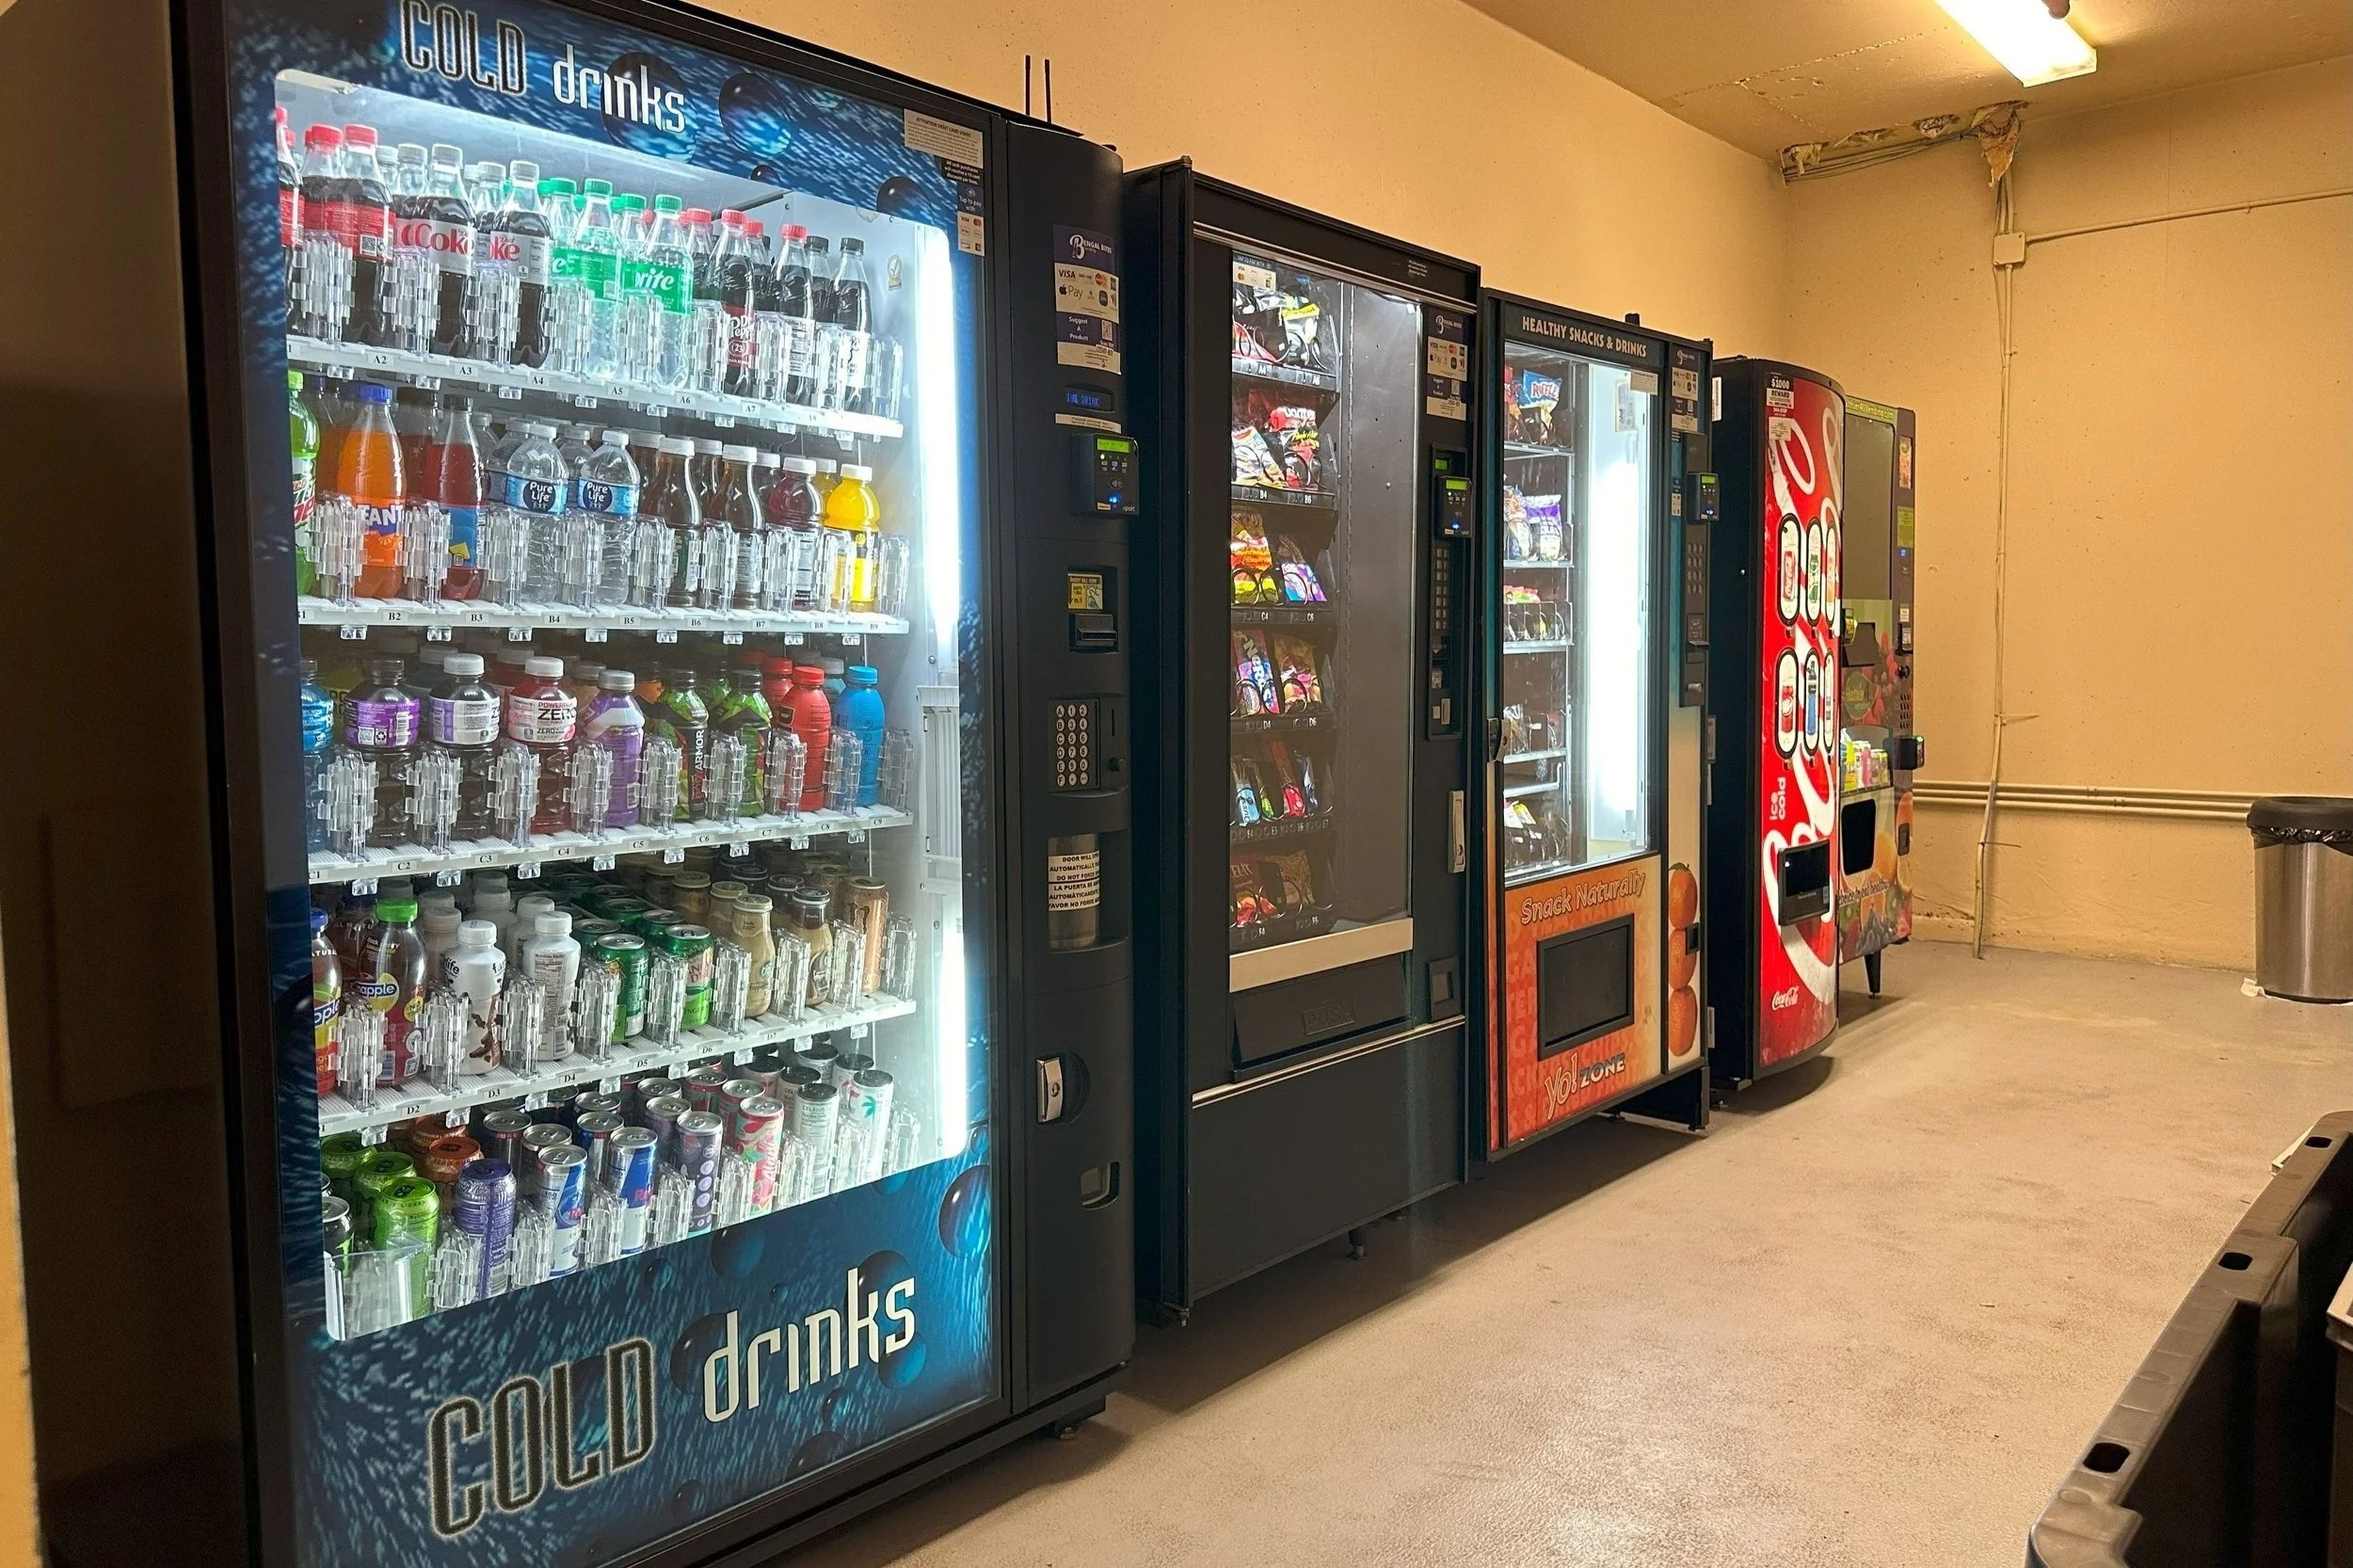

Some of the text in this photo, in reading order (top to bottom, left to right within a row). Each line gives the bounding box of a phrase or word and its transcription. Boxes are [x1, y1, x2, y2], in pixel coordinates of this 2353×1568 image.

[401, 0, 686, 134] COLD drinks
[916, 117, 937, 127] ATTENTION
[415, 224, 474, 257] Coke
[1058, 269, 1076, 279] VISA
[1068, 285, 1083, 300] Pay
[1068, 316, 1088, 325] Suggest
[1522, 316, 1647, 358] HEALTHY SNACKS & DRINKS
[373, 354, 387, 364] A2
[458, 366, 472, 376] A3
[531, 376, 544, 385] A4
[611, 386, 623, 395] A5
[679, 395, 691, 404] A6
[745, 404, 757, 413] A7
[1771, 378, 1790, 390] $1000
[1771, 390, 1790, 398] REWARD
[530, 481, 553, 494] Pure
[586, 481, 608, 494] Pure
[532, 491, 550, 503] Life
[588, 490, 605, 503] Life
[1259, 490, 1312, 504] B4 B6
[357, 504, 405, 526] FANT
[388, 612, 402, 621] B2
[471, 613, 484, 622] B3
[549, 616, 561, 624] B4
[623, 616, 635, 625] B5
[690, 618, 701, 627] B6
[756, 619, 766, 629] B7
[1261, 612, 1315, 622] C4 C6
[537, 708, 577, 721] ZERO
[1057, 735, 1063, 744] C
[1069, 734, 1074, 743] 5
[1069, 748, 1074, 757] 7
[1080, 747, 1085, 756] 8
[1058, 762, 1063, 771] E
[1777, 776, 1786, 821] cold
[1769, 791, 1778, 821] Ice
[397, 861, 410, 871] C2
[479, 855, 492, 863] C3
[557, 848, 570, 856] C4
[632, 840, 644, 849] C5
[698, 835, 710, 843] C6
[761, 828, 773, 837] C7
[1521, 868, 1646, 925] Snack Naturally
[406, 1105, 420, 1115] D2
[488, 1089, 501, 1098] D3
[564, 1074, 576, 1083] D4
[636, 1059, 648, 1068] D5
[702, 1045, 713, 1054] D6
[767, 1032, 777, 1041] D7
[1580, 1053, 1626, 1087] ZONE
[428, 1267, 916, 1542] COLD drinks
